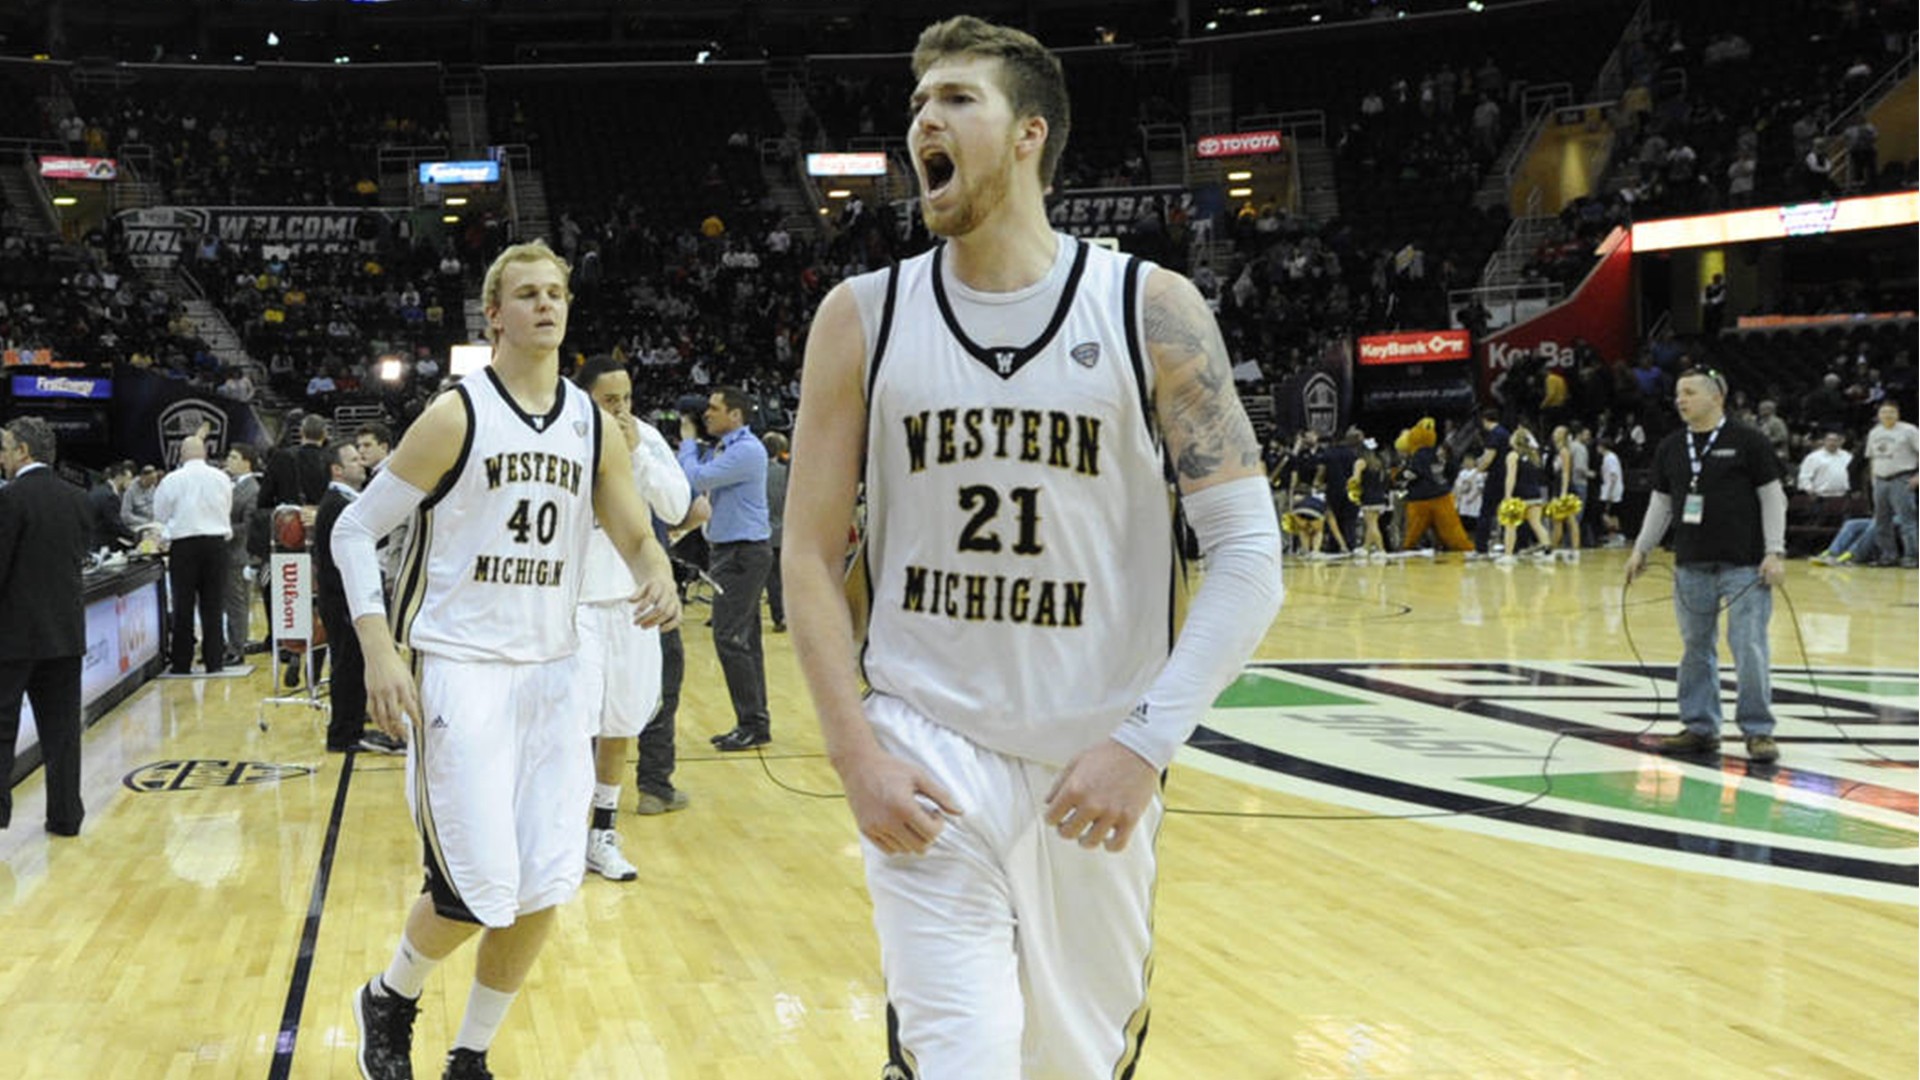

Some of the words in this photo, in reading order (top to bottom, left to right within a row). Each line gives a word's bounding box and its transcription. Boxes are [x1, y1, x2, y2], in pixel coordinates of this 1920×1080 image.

[1222, 135, 1280, 151] TOYOTA
[996, 352, 1016, 374] W
[1361, 339, 1429, 360] KeyBank
[903, 407, 1103, 477] WESTERN
[484, 452, 583, 497] WESTERN
[506, 498, 558, 546] 40
[957, 484, 1045, 556] 21
[473, 555, 565, 588] MICHIGN
[282, 562, 299, 630] Wilson
[902, 565, 1088, 628] MICHIGAN
